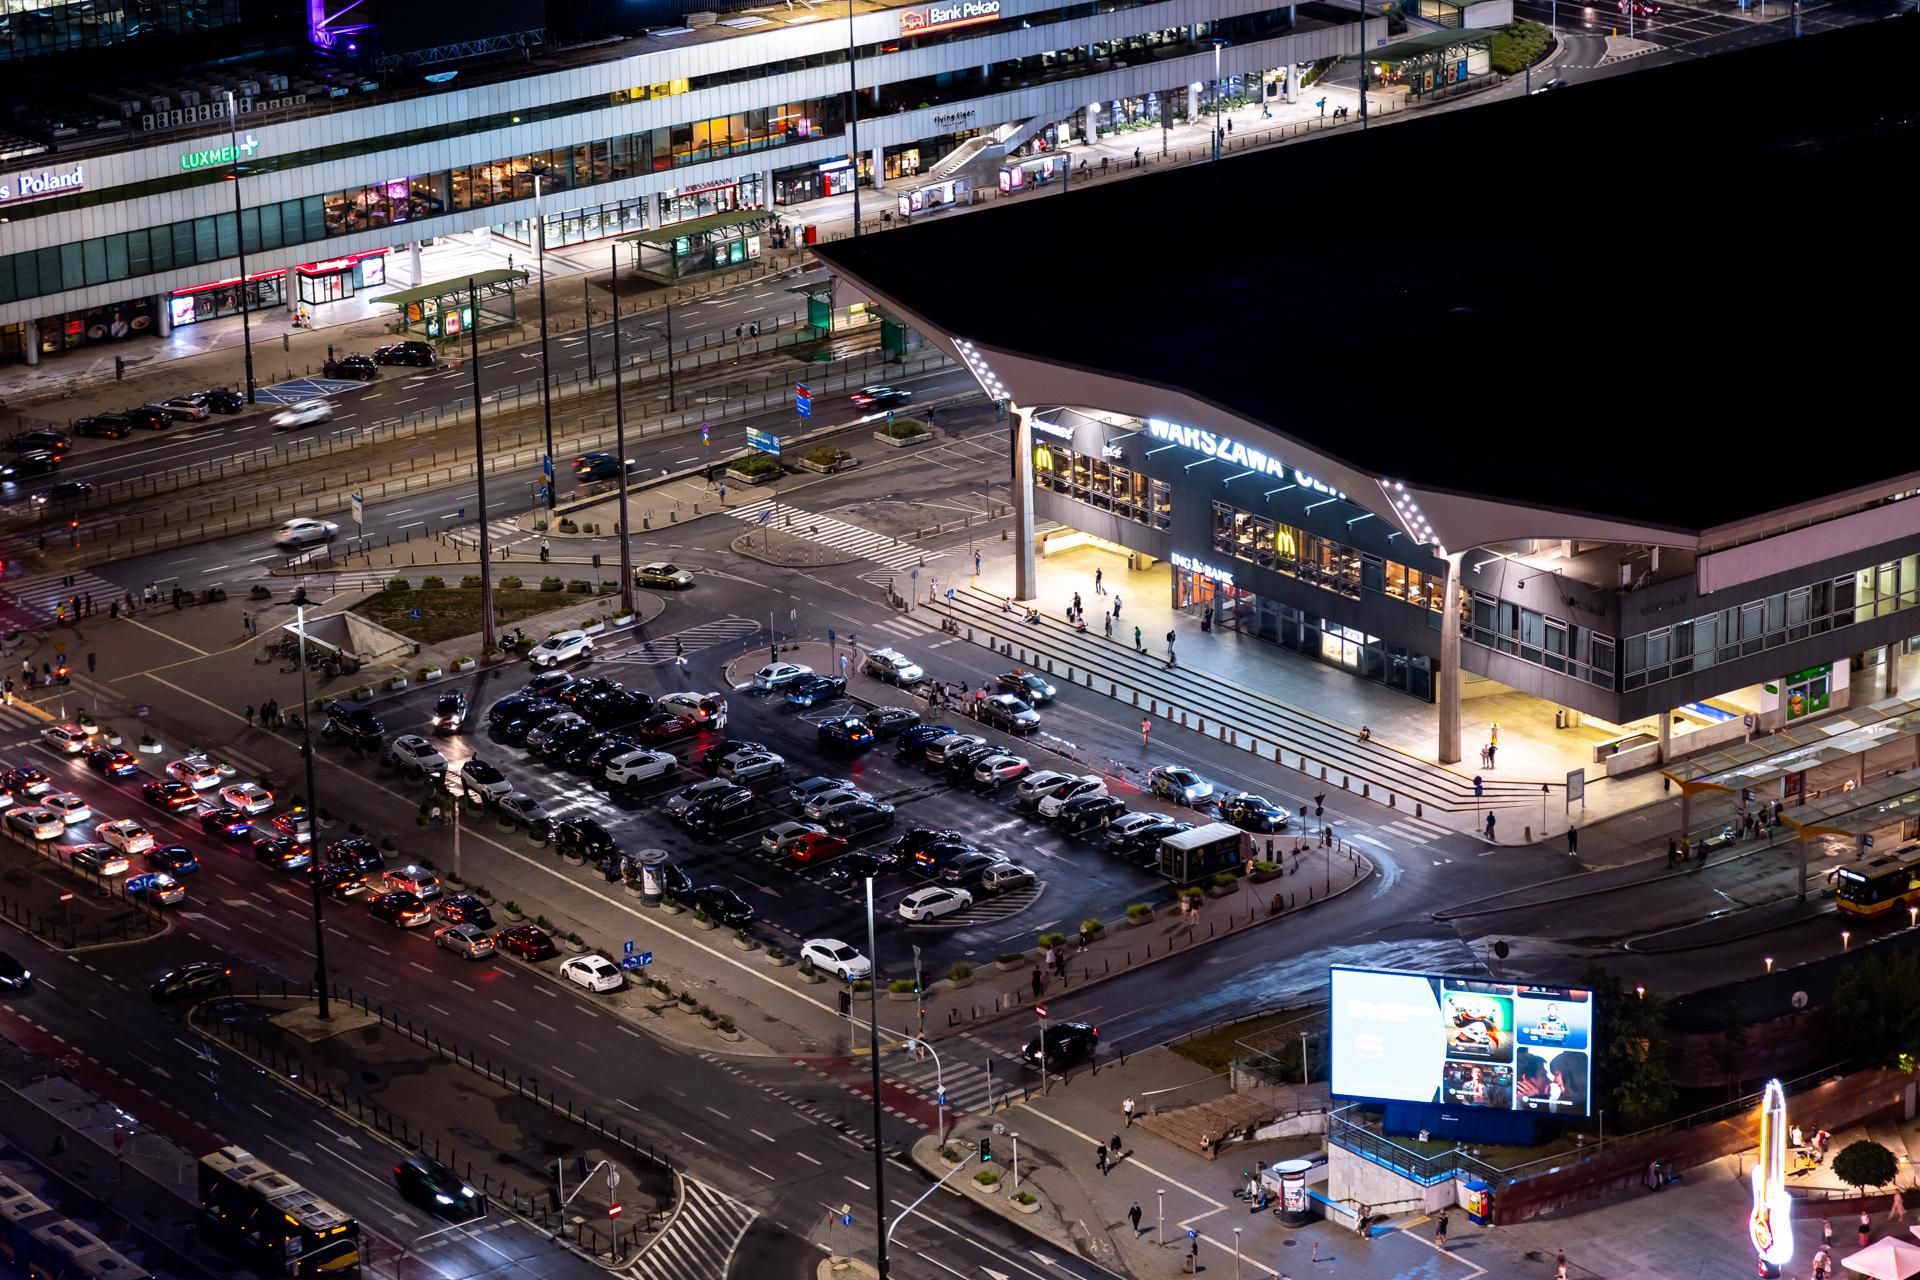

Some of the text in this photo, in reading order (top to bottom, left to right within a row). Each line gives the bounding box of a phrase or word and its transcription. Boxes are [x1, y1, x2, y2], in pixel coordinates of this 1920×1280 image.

[930, 1, 999, 23] Bank Pekao
[19, 166, 83, 196] Poland
[1171, 552, 1234, 586] ING BANK
